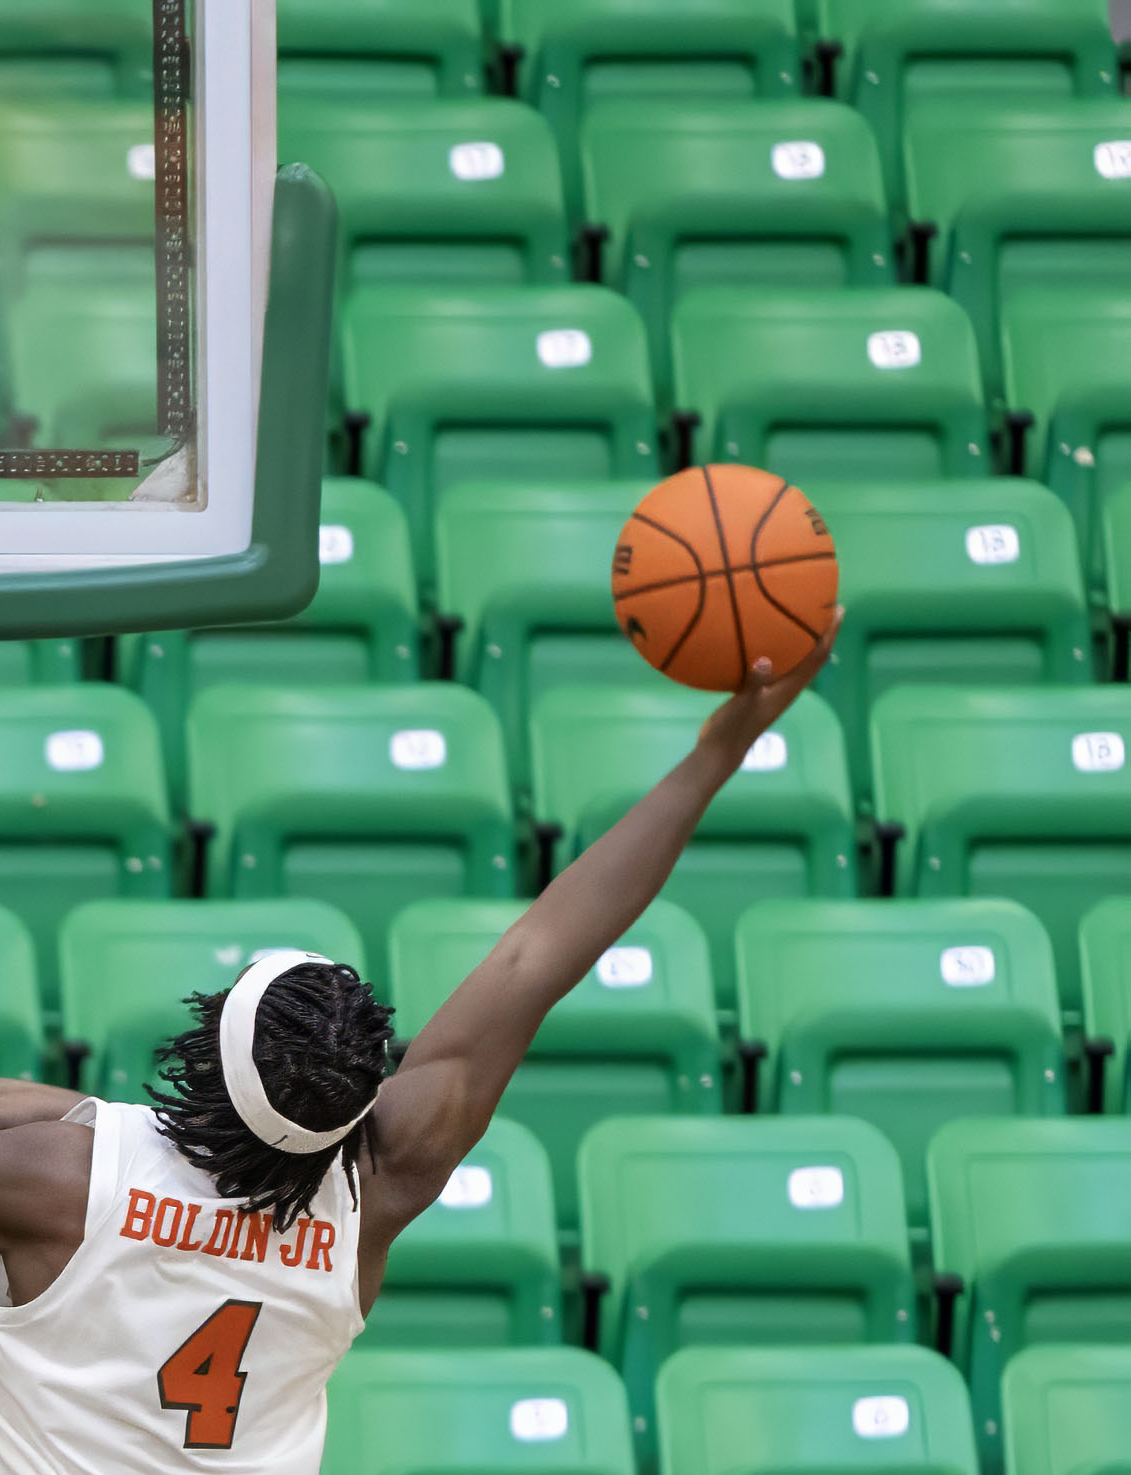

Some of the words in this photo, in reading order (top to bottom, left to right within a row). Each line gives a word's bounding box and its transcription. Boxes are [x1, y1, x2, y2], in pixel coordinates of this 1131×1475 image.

[119, 1188, 274, 1263] BOLDIN
[279, 1217, 336, 1272] JR
[157, 1298, 263, 1450] 4
